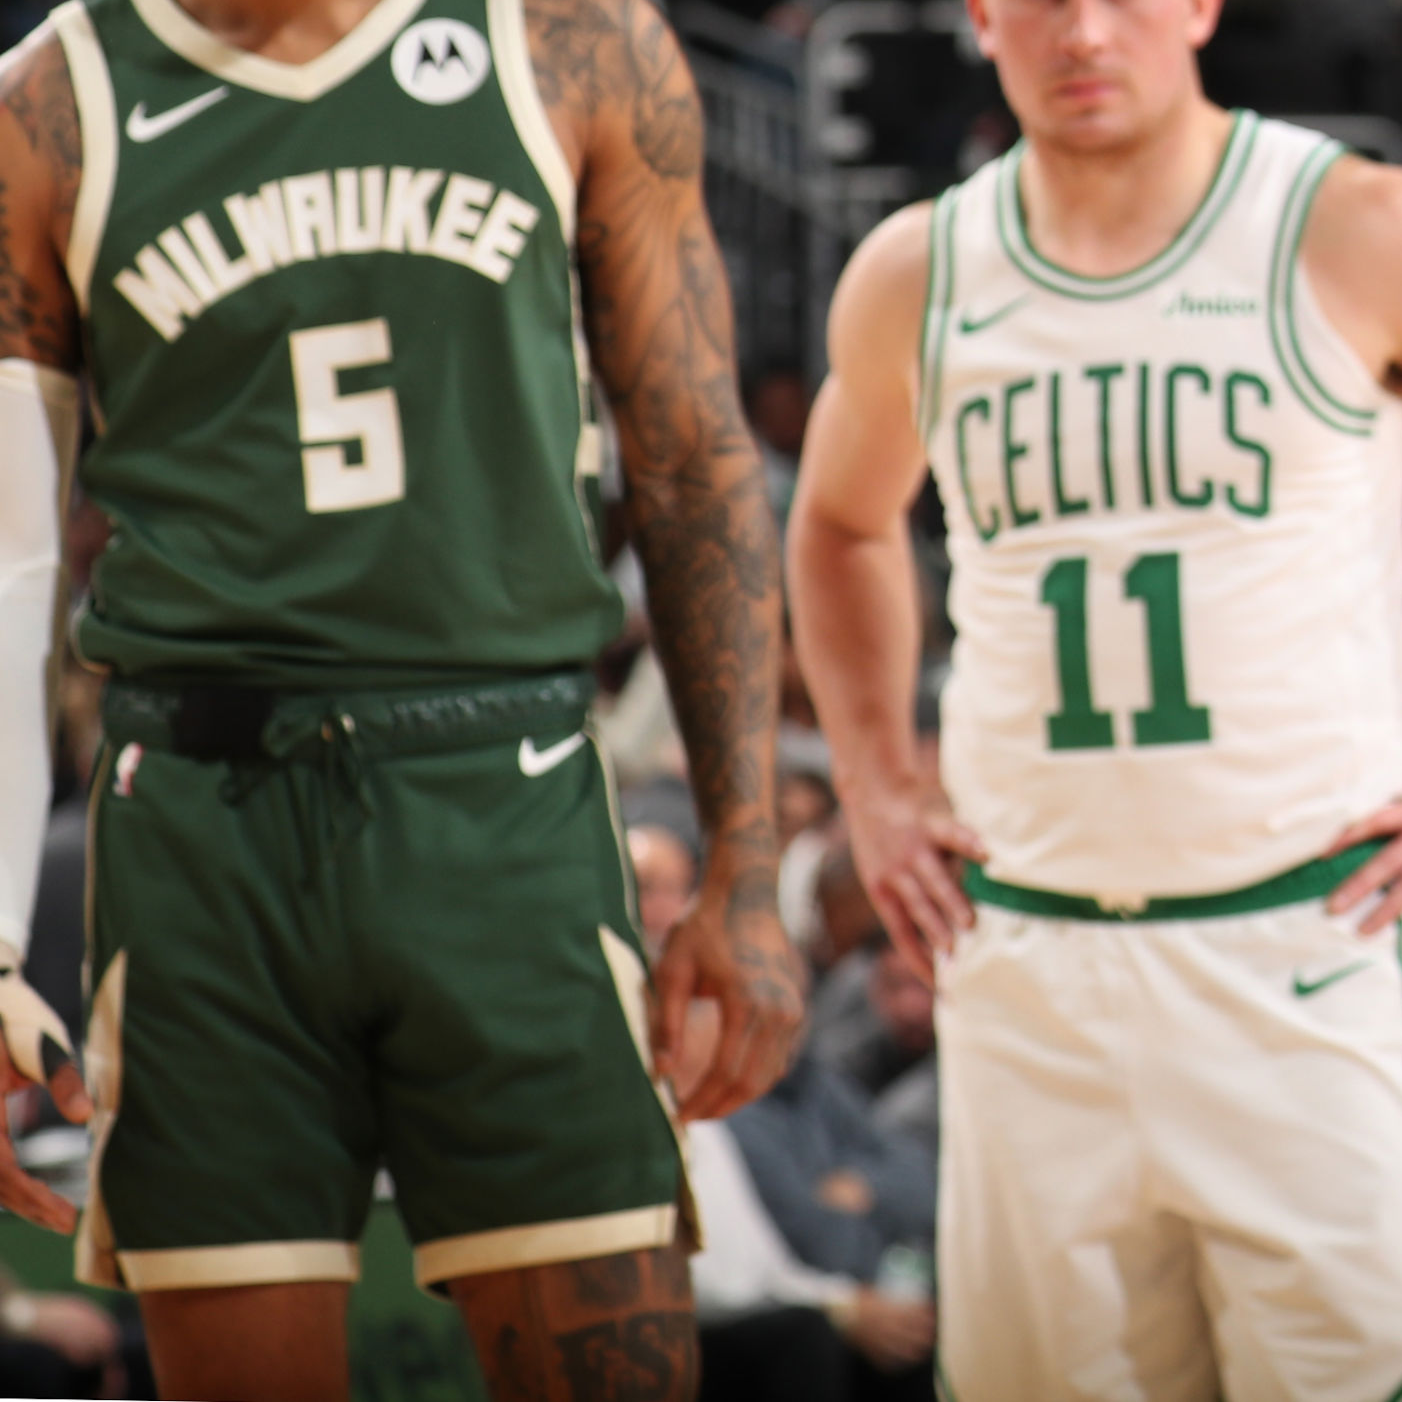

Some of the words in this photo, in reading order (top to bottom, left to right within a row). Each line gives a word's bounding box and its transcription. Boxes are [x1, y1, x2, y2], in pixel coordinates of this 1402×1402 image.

[113, 165, 541, 343] MILWAUKEE
[288, 317, 406, 515] 5
[956, 361, 1272, 543] CELTICS
[1040, 550, 1214, 750] 11
